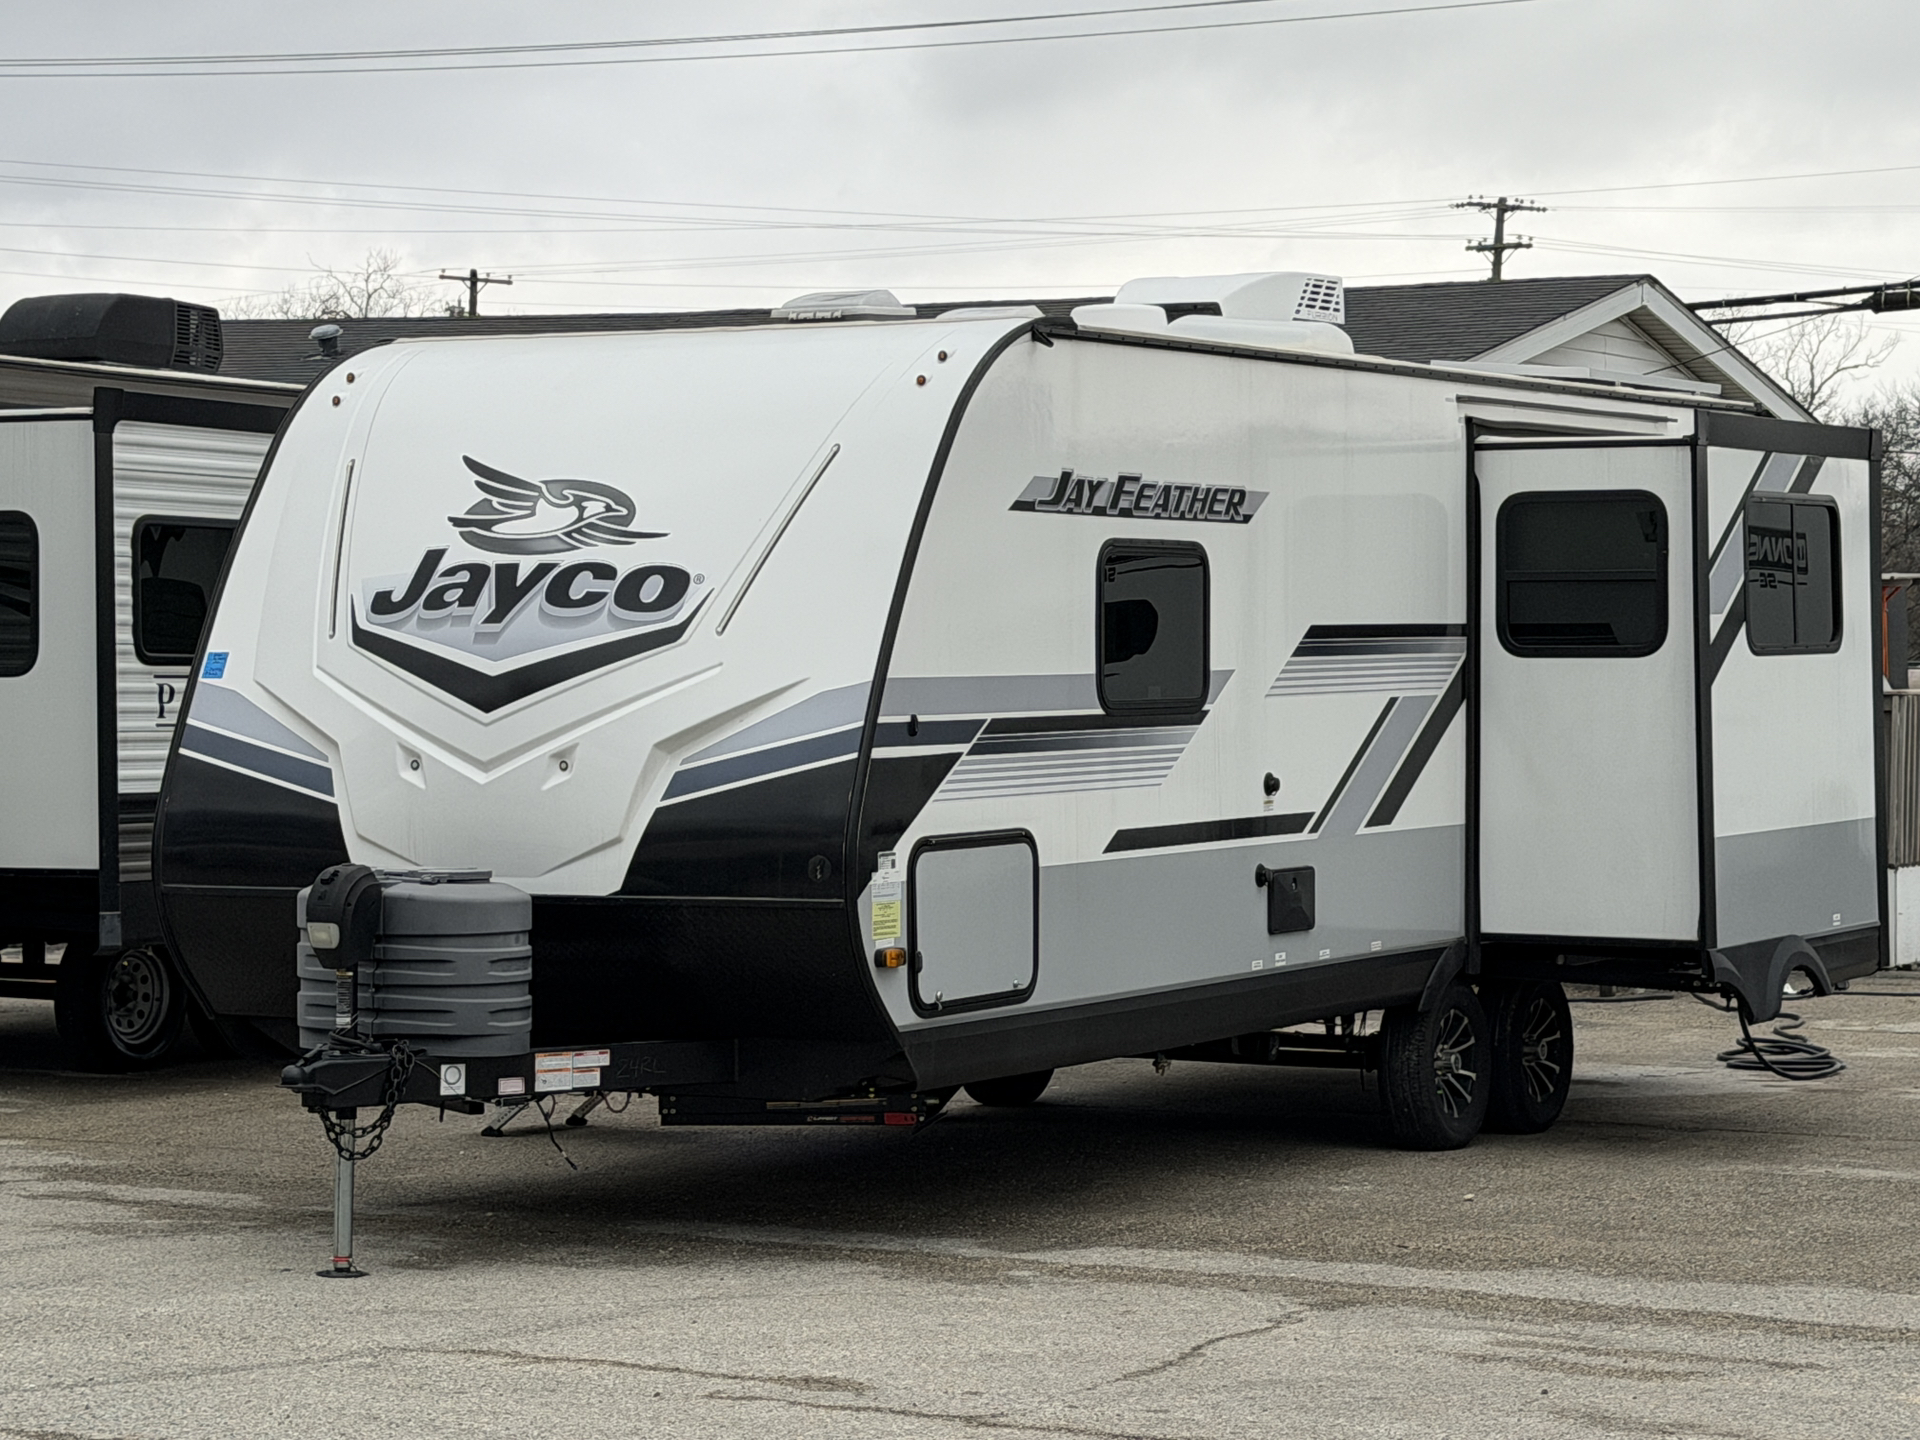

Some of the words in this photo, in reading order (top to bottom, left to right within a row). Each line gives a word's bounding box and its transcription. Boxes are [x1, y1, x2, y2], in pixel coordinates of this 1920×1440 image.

[1037, 469, 1106, 511] JAY
[1107, 473, 1247, 519] FEATHER
[370, 546, 692, 626] Jayco
